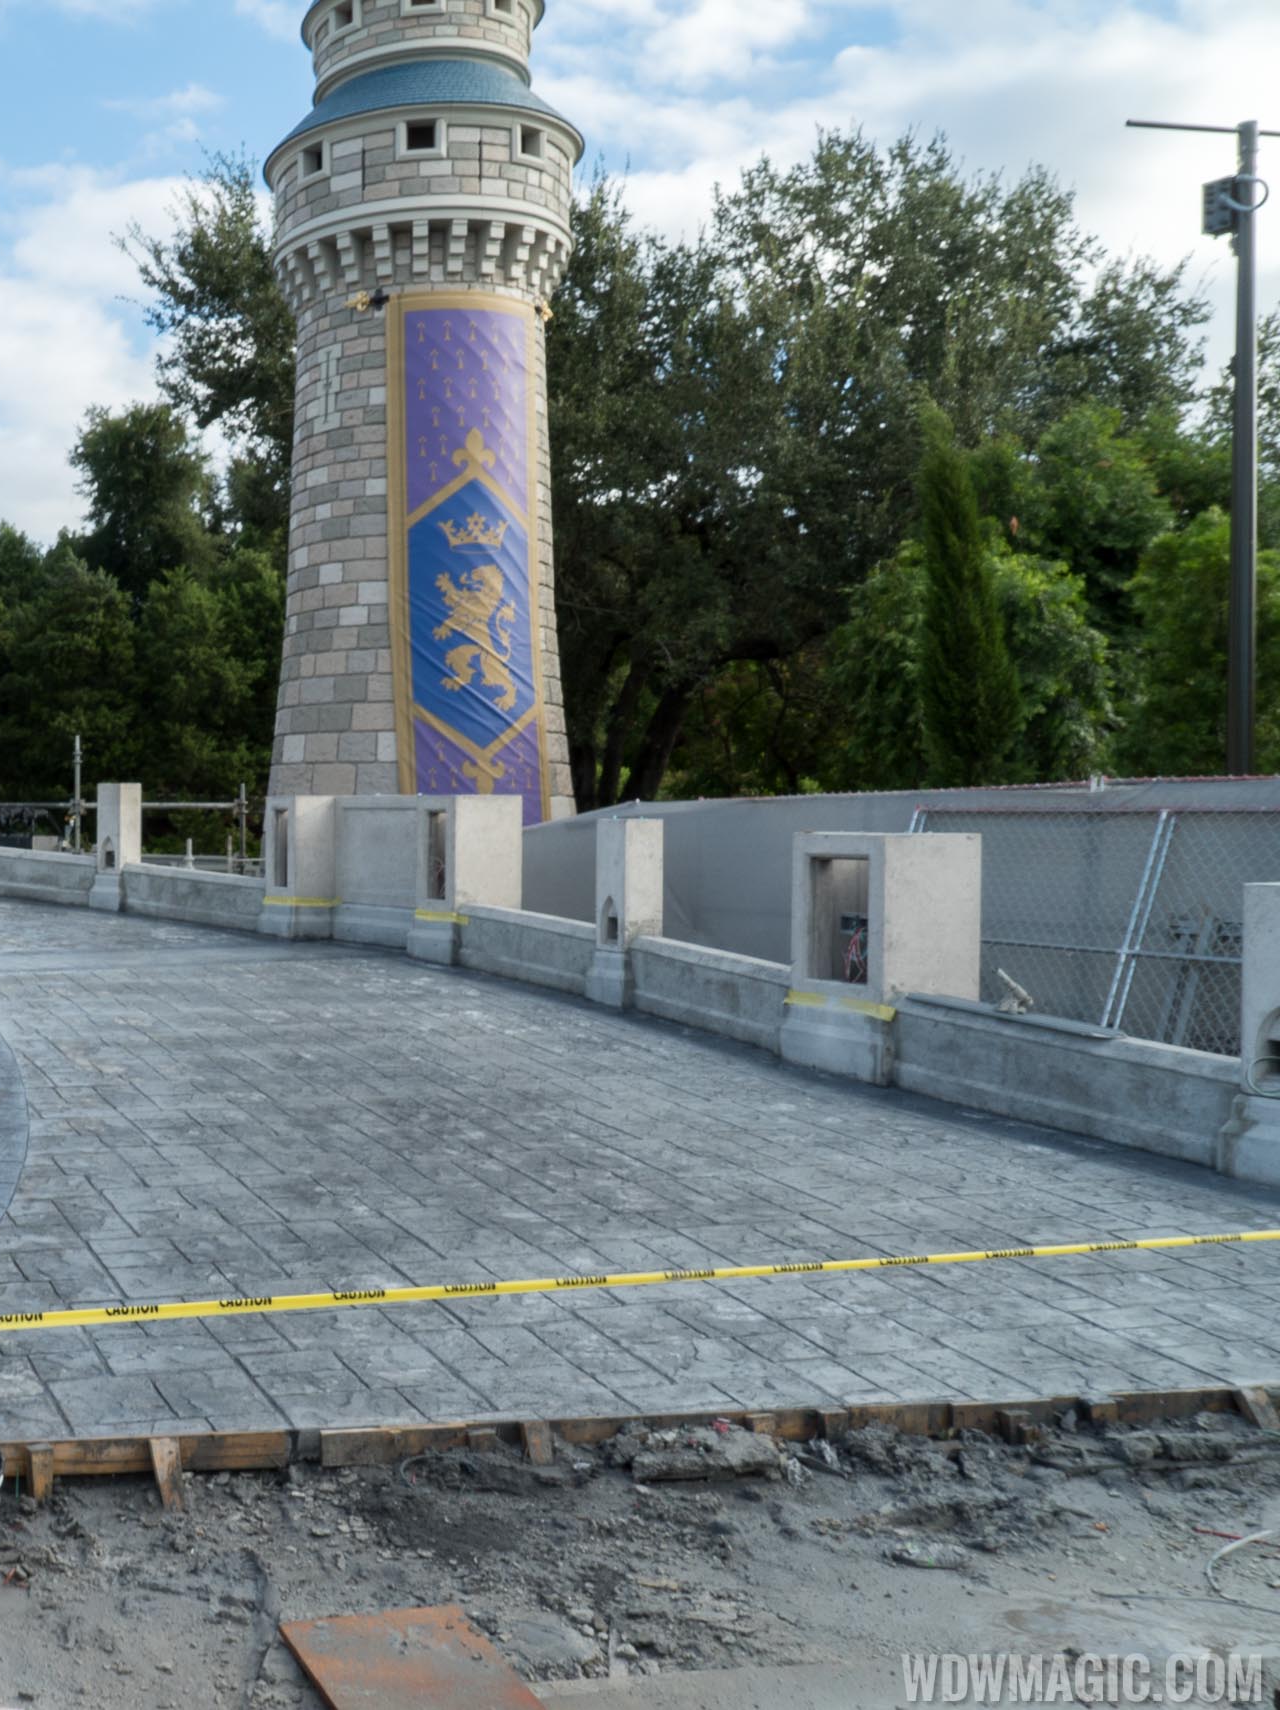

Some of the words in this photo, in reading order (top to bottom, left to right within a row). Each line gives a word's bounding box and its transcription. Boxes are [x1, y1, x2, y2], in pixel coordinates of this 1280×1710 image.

[105, 1304, 158, 1316] CAUTION
[219, 1296, 272, 1308] CAUTION
[333, 1289, 385, 1300] CAUTION
